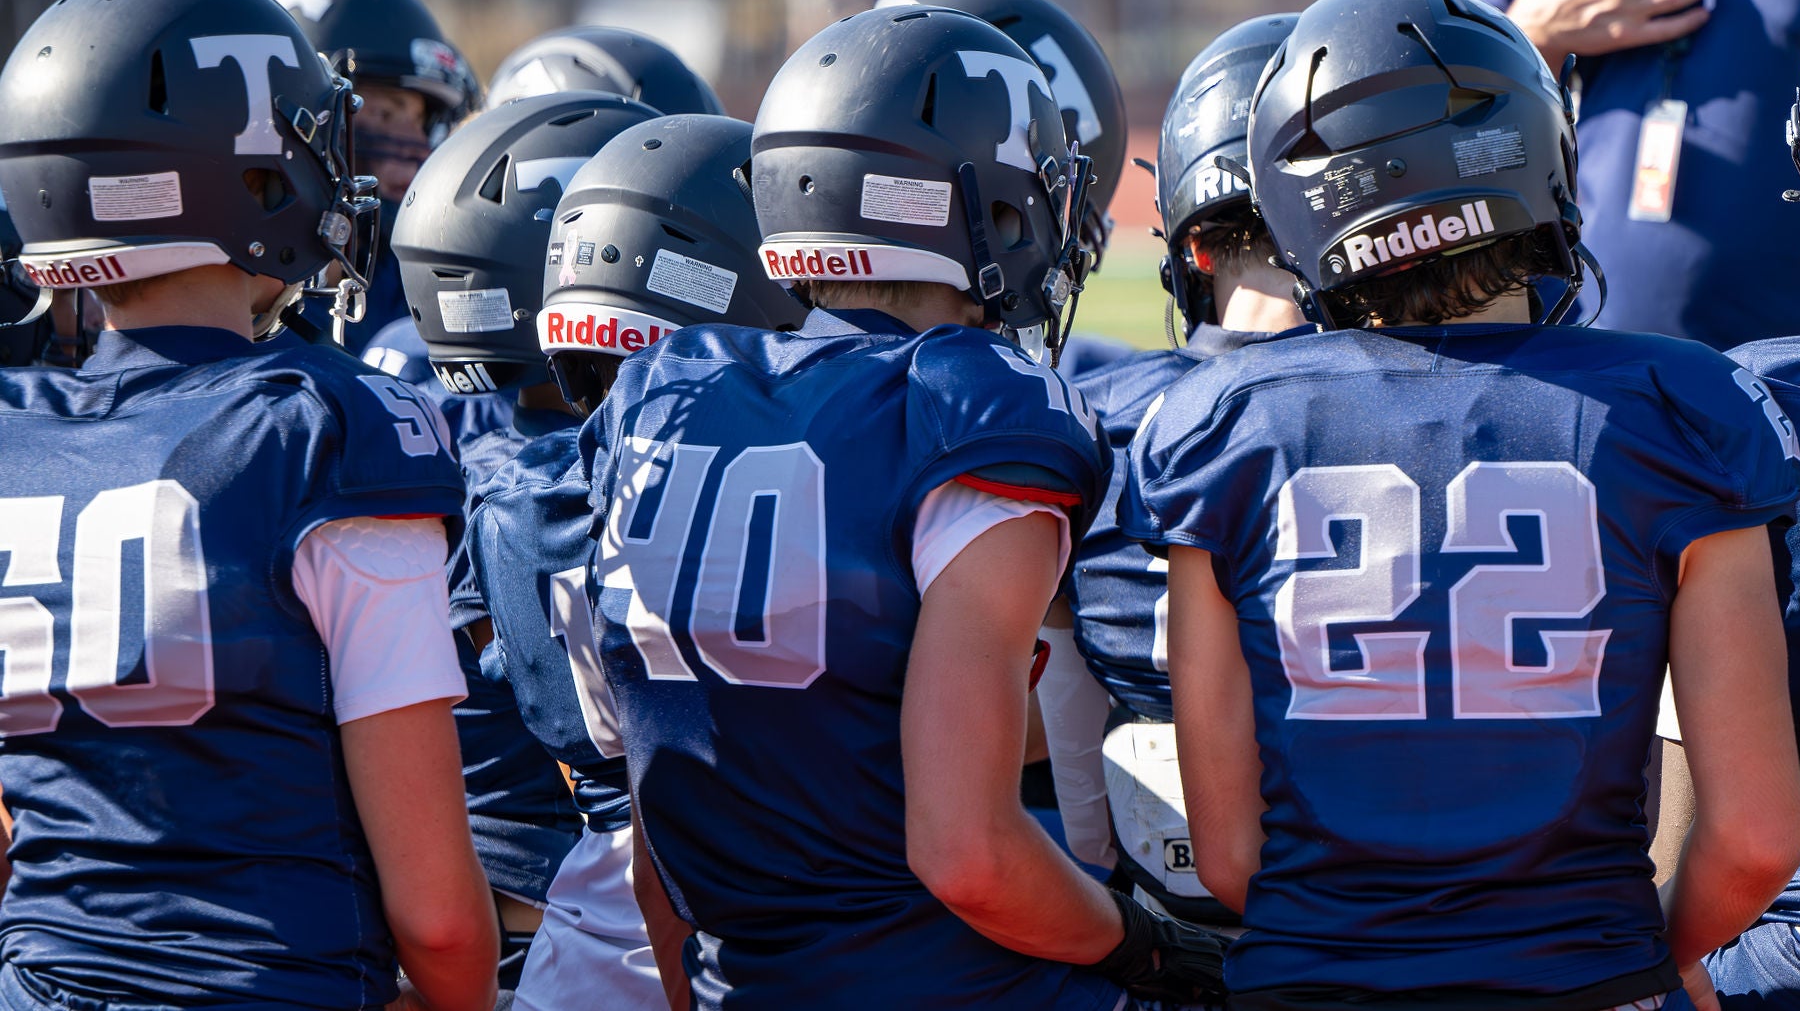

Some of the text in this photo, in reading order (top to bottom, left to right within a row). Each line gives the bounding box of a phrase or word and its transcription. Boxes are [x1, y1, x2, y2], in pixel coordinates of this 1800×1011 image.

[189, 34, 300, 155] T
[956, 50, 1054, 173] T
[893, 179, 924, 188] WARNING
[684, 257, 713, 272] WARNING
[764, 249, 873, 275] Riddell
[1343, 200, 1495, 273] Riddell
[548, 312, 676, 352] Riddel
[597, 436, 827, 690] 40
[1275, 461, 1613, 720] 22
